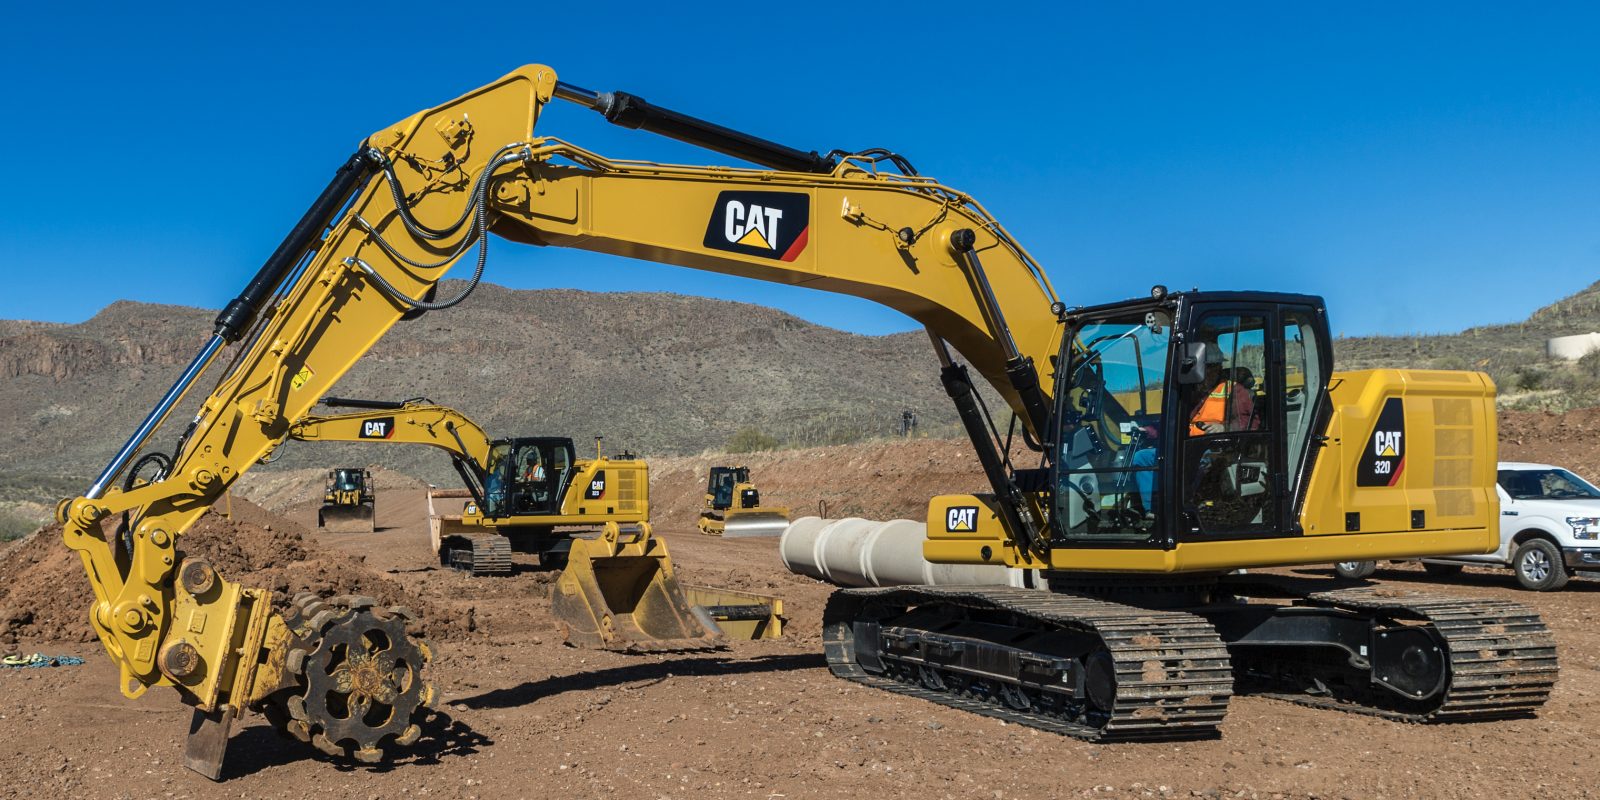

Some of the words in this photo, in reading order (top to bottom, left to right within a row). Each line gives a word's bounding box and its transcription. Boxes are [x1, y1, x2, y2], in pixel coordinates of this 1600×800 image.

[725, 200, 783, 250] CAT
[365, 421, 386, 436] CAT
[1375, 430, 1402, 456] CAT
[1374, 460, 1391, 474] 320
[592, 481, 604, 490] CAT
[948, 508, 976, 530] CAT
